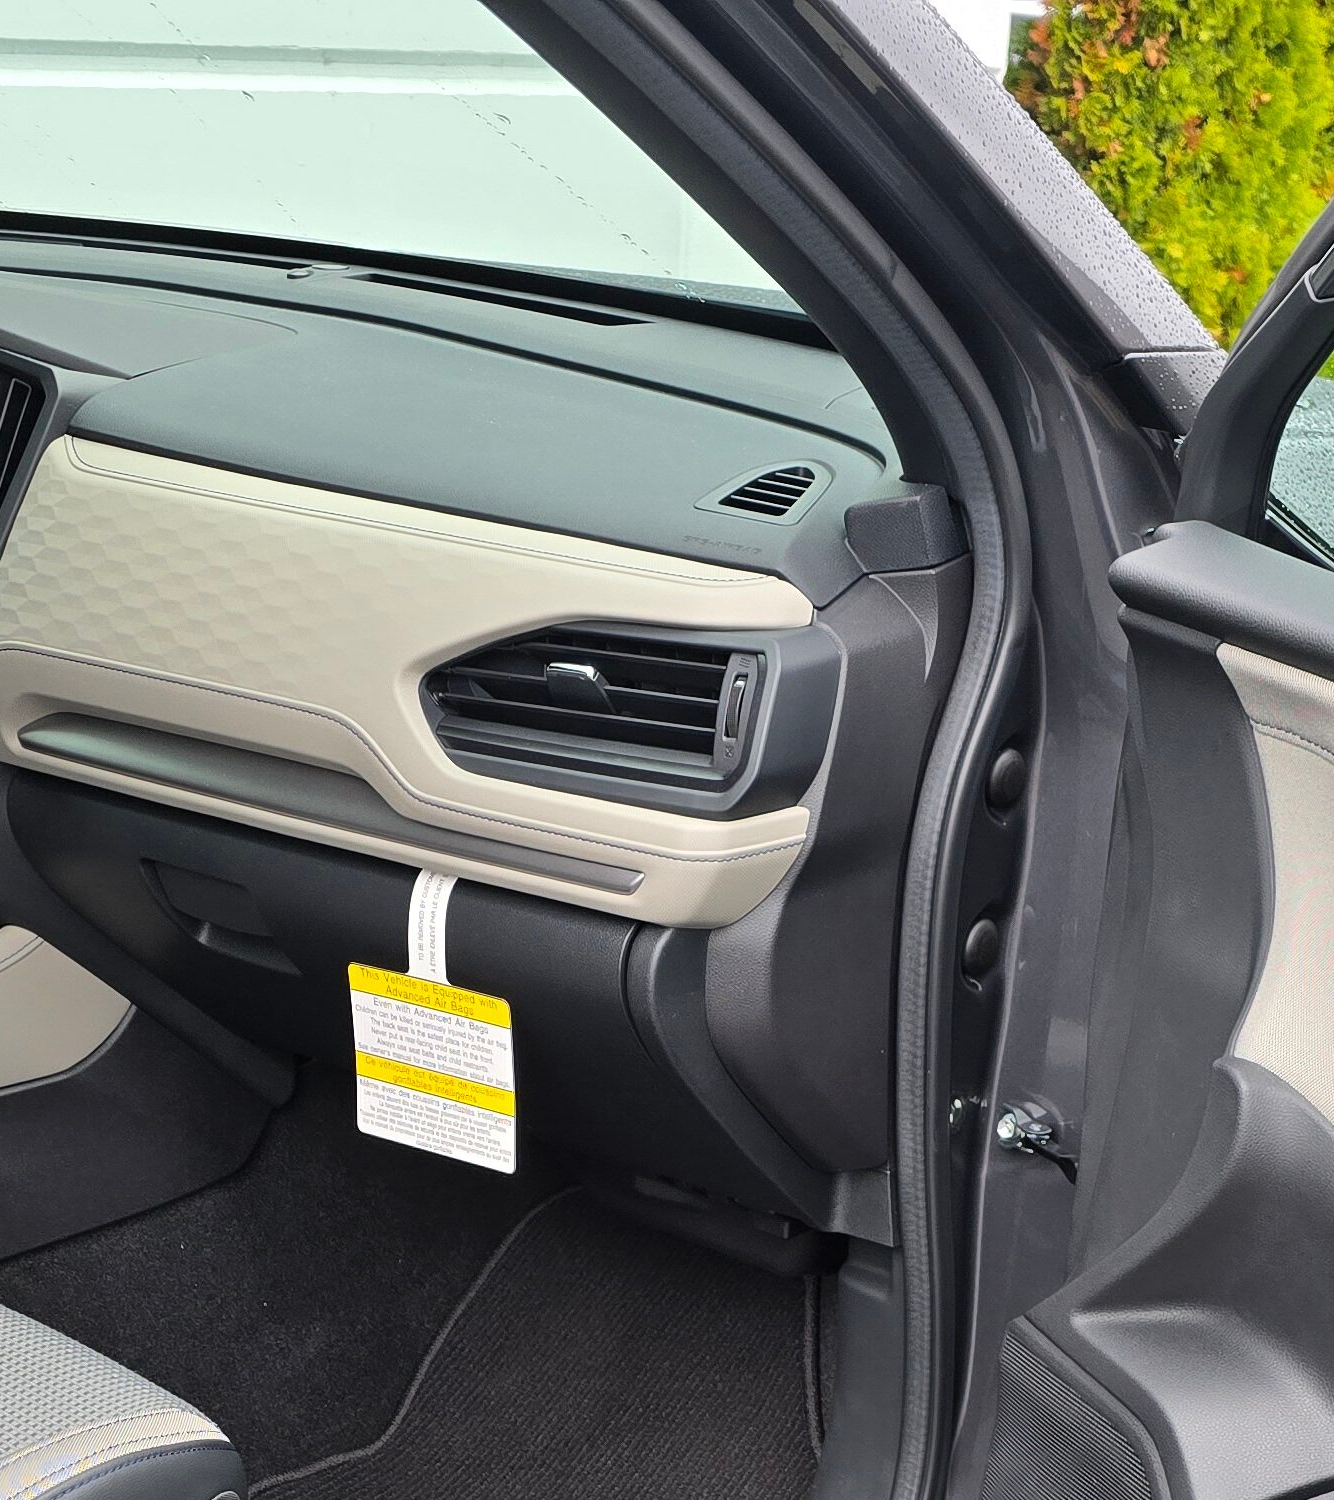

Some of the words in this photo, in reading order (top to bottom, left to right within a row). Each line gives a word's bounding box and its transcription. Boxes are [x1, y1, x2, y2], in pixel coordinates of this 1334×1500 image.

[360, 967, 379, 980] This
[383, 972, 416, 989] Vehicle
[432, 984, 475, 1006] Equipped
[479, 995, 497, 1009] with
[385, 984, 430, 1004] Advanced
[434, 996, 446, 1008] Air
[450, 1000, 474, 1017] Bags
[373, 996, 392, 1009] Even
[395, 1002, 410, 1014] with
[413, 1006, 451, 1024] Advanced
[454, 1017, 465, 1028] Air
[468, 1020, 488, 1036] Bags
